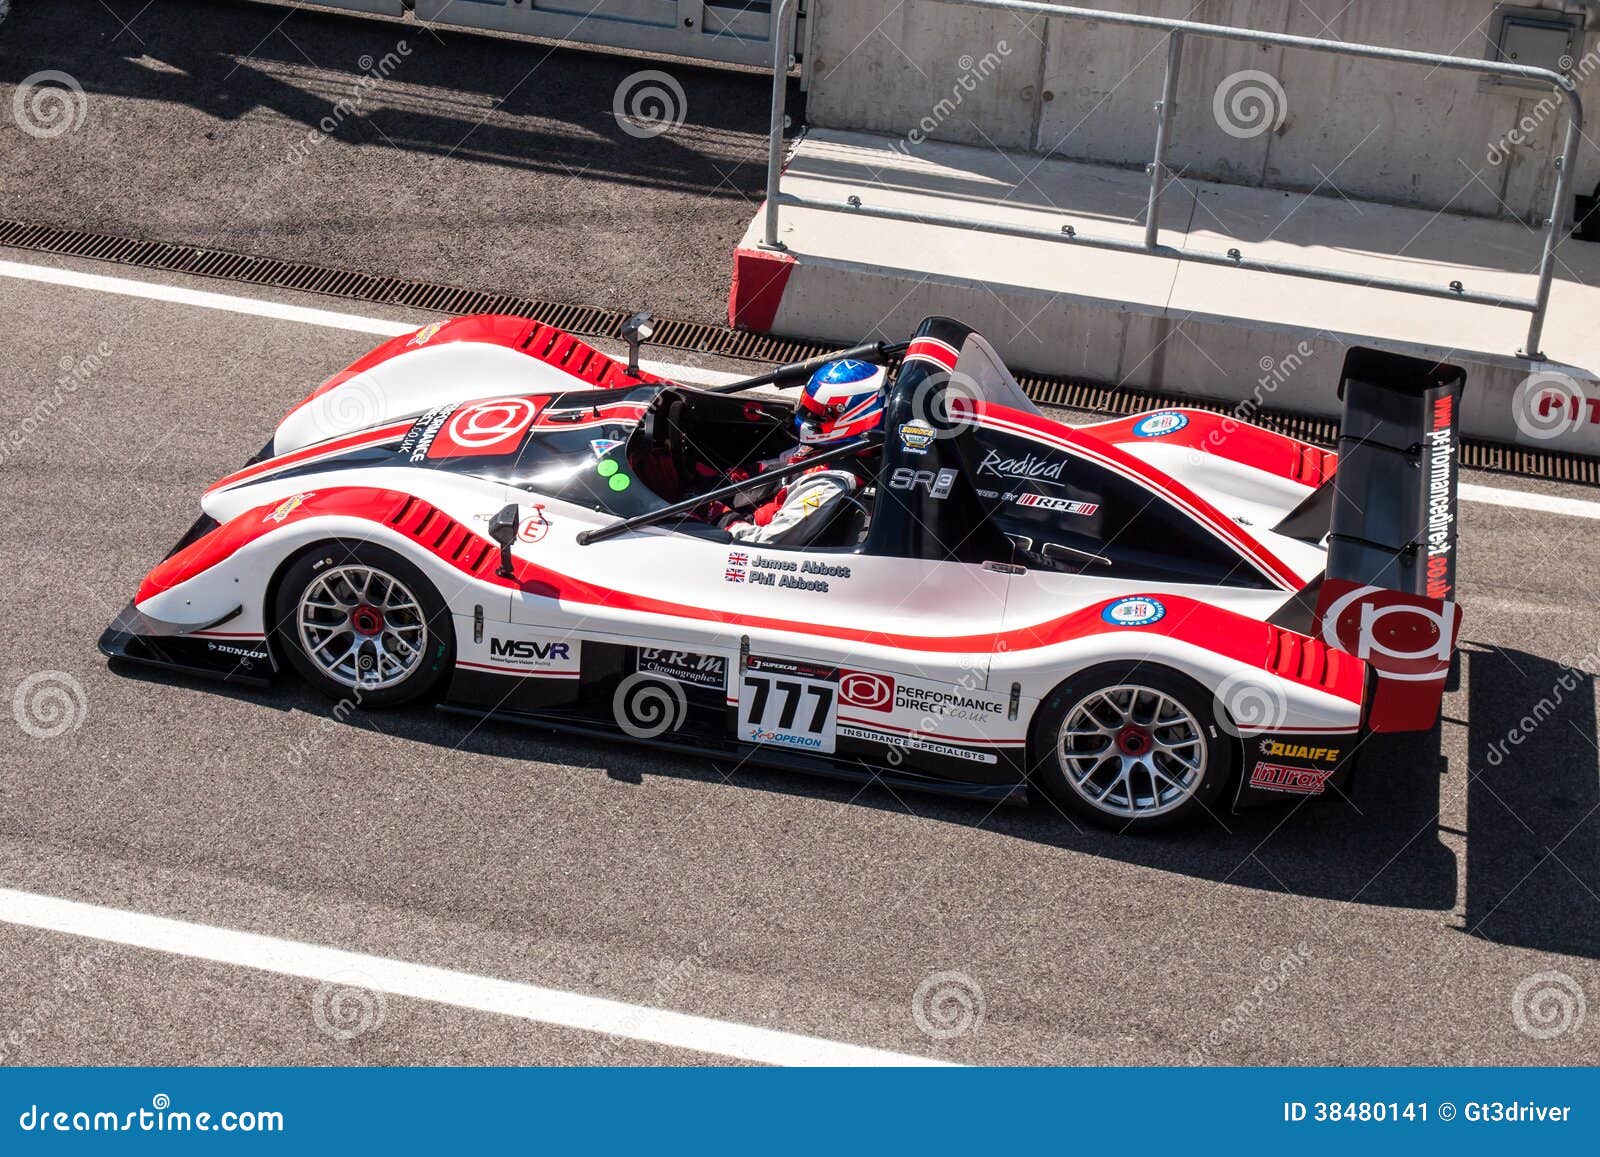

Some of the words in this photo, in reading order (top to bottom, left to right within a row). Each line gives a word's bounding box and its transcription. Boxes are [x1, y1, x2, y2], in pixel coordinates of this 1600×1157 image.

[976, 449, 1068, 479] Radical
[1035, 497, 1080, 512] RPE
[523, 520, 543, 538] E
[751, 555, 798, 571] James
[800, 560, 851, 578] Abbott
[748, 570, 776, 586] Phil
[778, 575, 829, 592] Abbott
[218, 644, 268, 659] DUNLOP
[490, 637, 570, 660] MSVR
[762, 661, 798, 671] SUPERCAR
[743, 676, 834, 734] 777
[895, 685, 1003, 714] PERFORMANCE
[843, 728, 909, 747] INSURANCE
[912, 741, 986, 761] SPECIALISTS
[1271, 742, 1340, 761] QUAIFE
